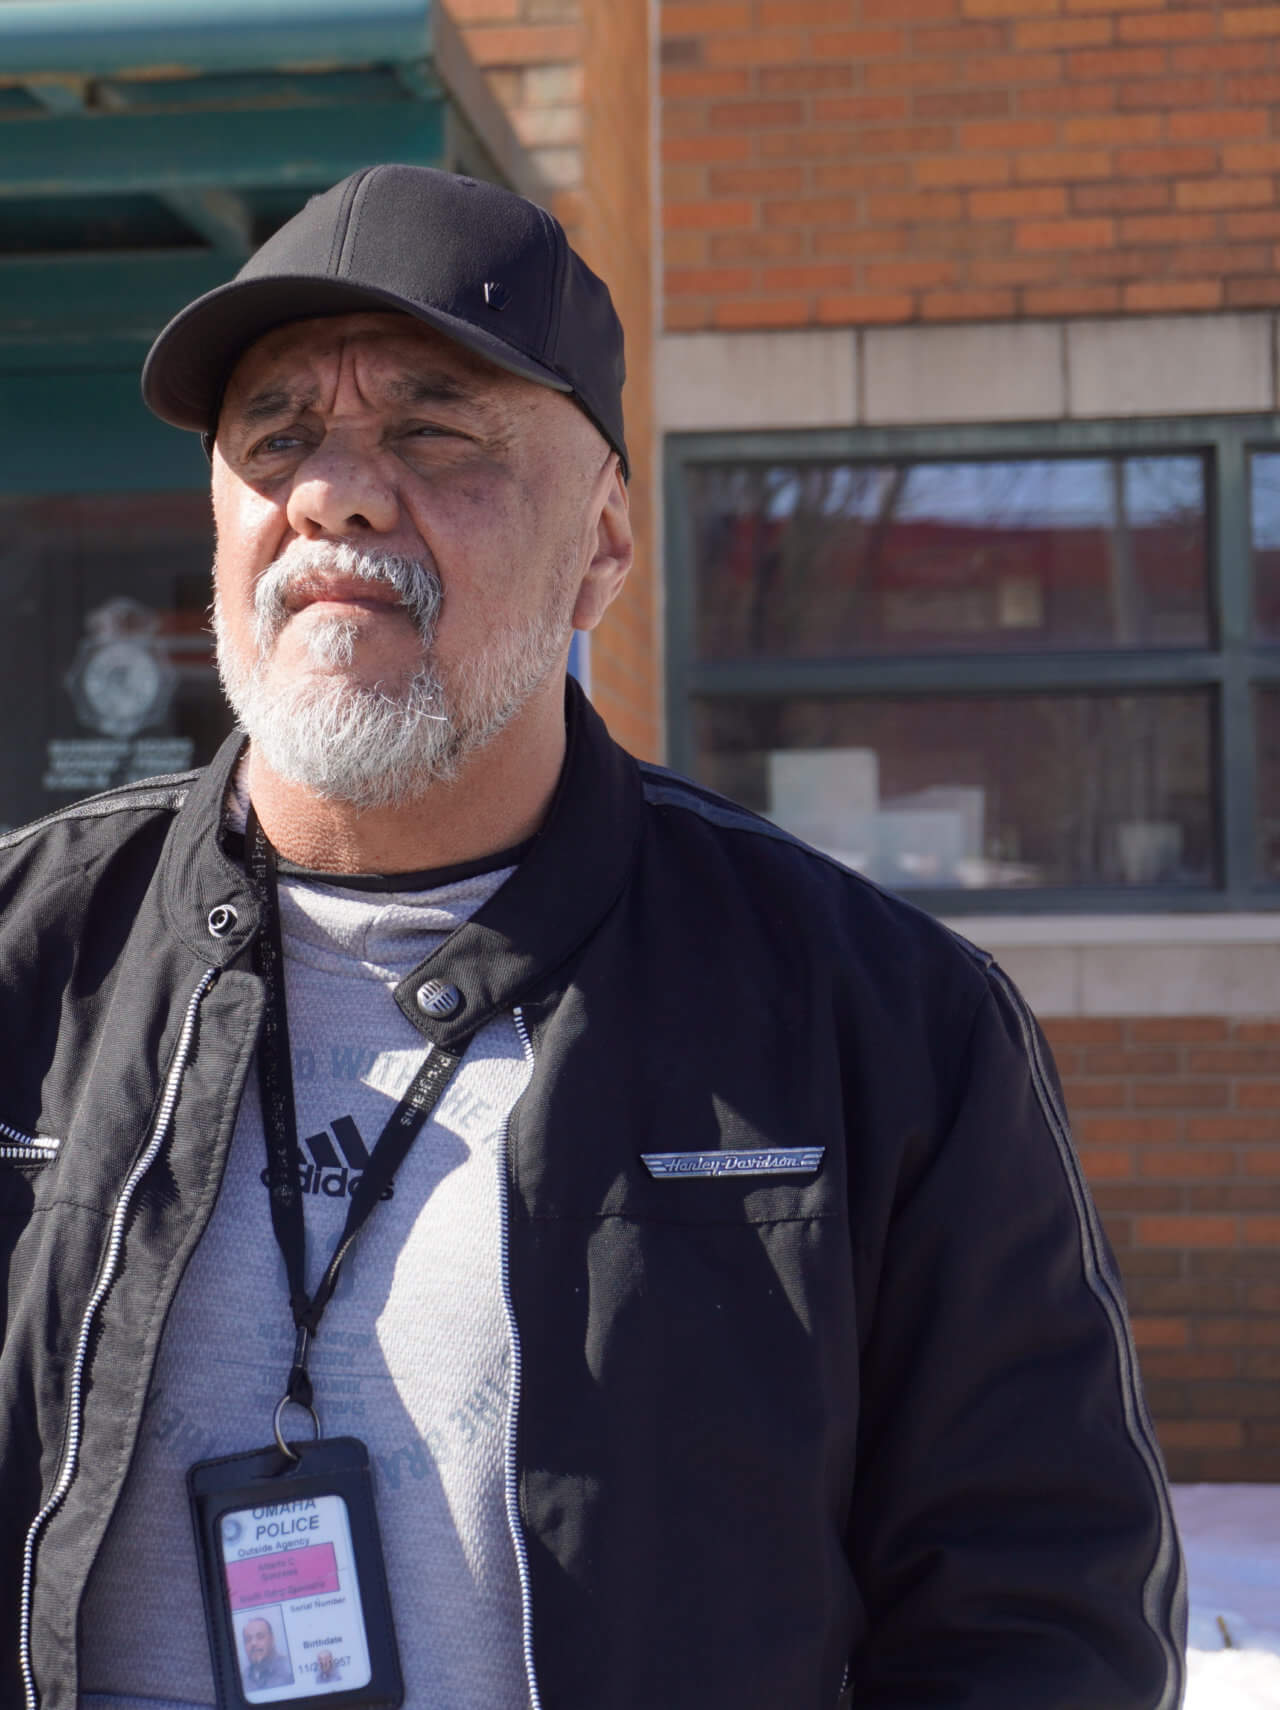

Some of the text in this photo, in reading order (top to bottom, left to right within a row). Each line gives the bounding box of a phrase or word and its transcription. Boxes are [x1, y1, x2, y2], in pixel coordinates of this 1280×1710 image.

[664, 1153, 798, 1176] Harley-Davidson
[252, 1499, 317, 1520] OMAHA
[256, 1514, 320, 1540] POLICE
[238, 1538, 311, 1557] Outside Agency
[290, 1597, 346, 1612] Serial Number
[303, 1636, 343, 1649] Birthdate
